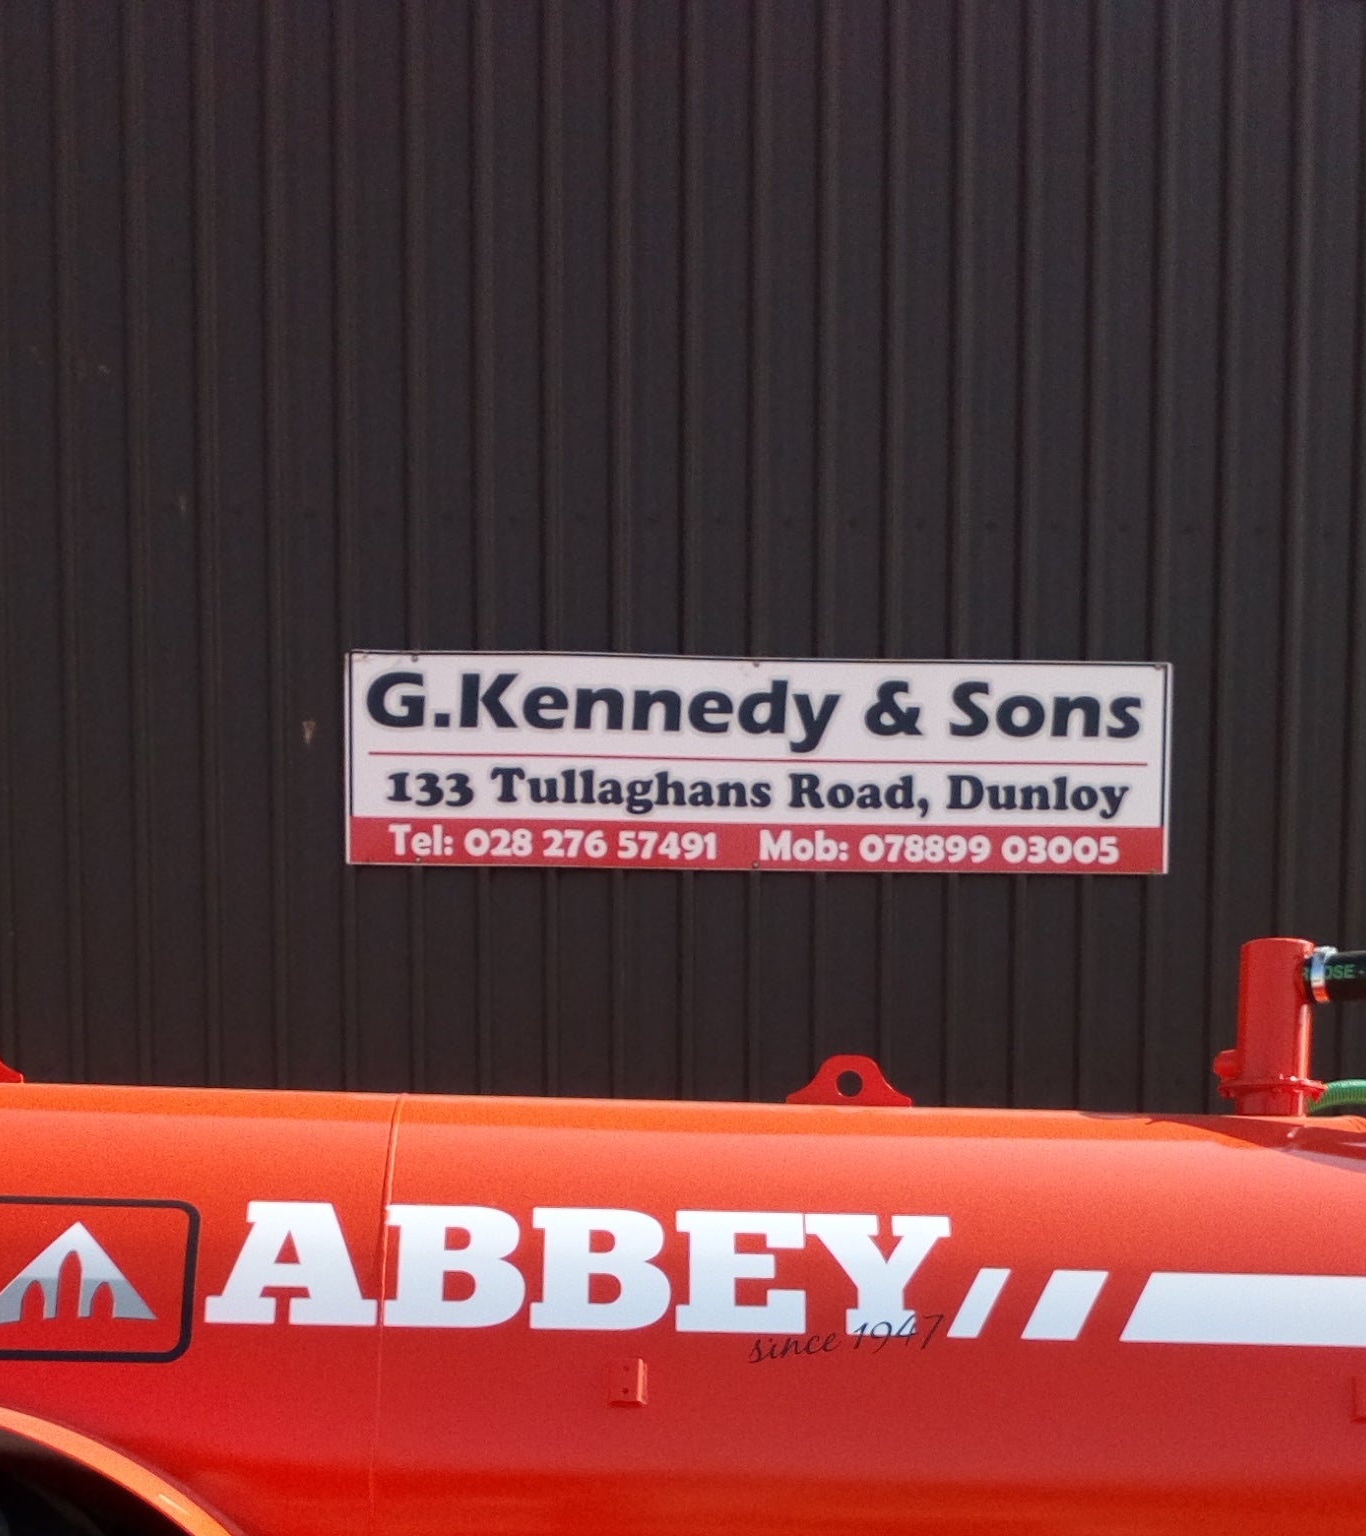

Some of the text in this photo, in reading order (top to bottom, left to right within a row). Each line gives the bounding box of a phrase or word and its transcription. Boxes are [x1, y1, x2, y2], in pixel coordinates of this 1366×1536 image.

[366, 671, 1142, 753] G.Kennedy & Sons
[387, 767, 1129, 819] 133 Tullaghans Road, Dunloy
[388, 824, 1119, 864] Tel: 028 276 57491 Mob: 078899 03005
[204, 1200, 952, 1336] ABBEY
[748, 1313, 944, 1364] since 1947
